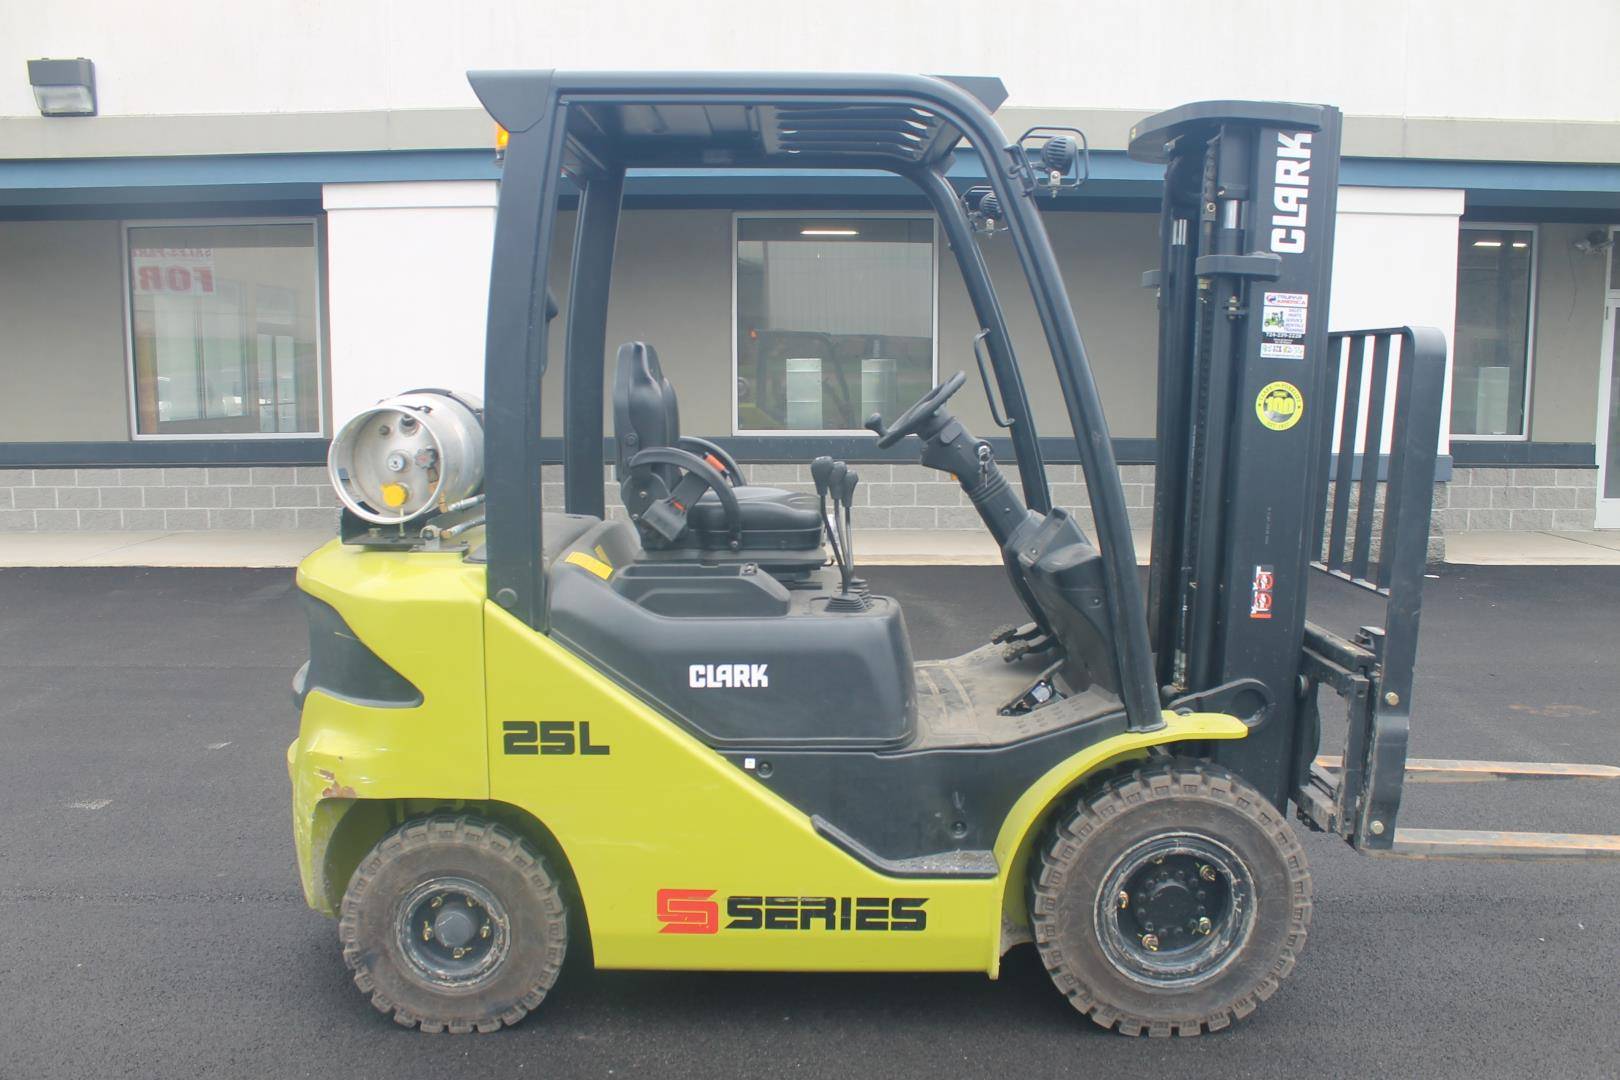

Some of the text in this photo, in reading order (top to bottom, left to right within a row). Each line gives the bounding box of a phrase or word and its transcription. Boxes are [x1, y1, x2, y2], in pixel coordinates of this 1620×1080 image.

[1270, 131, 1312, 254] CLARK
[689, 664, 768, 688] CLARK
[503, 721, 610, 755] 25L
[724, 896, 930, 931] SERIES
